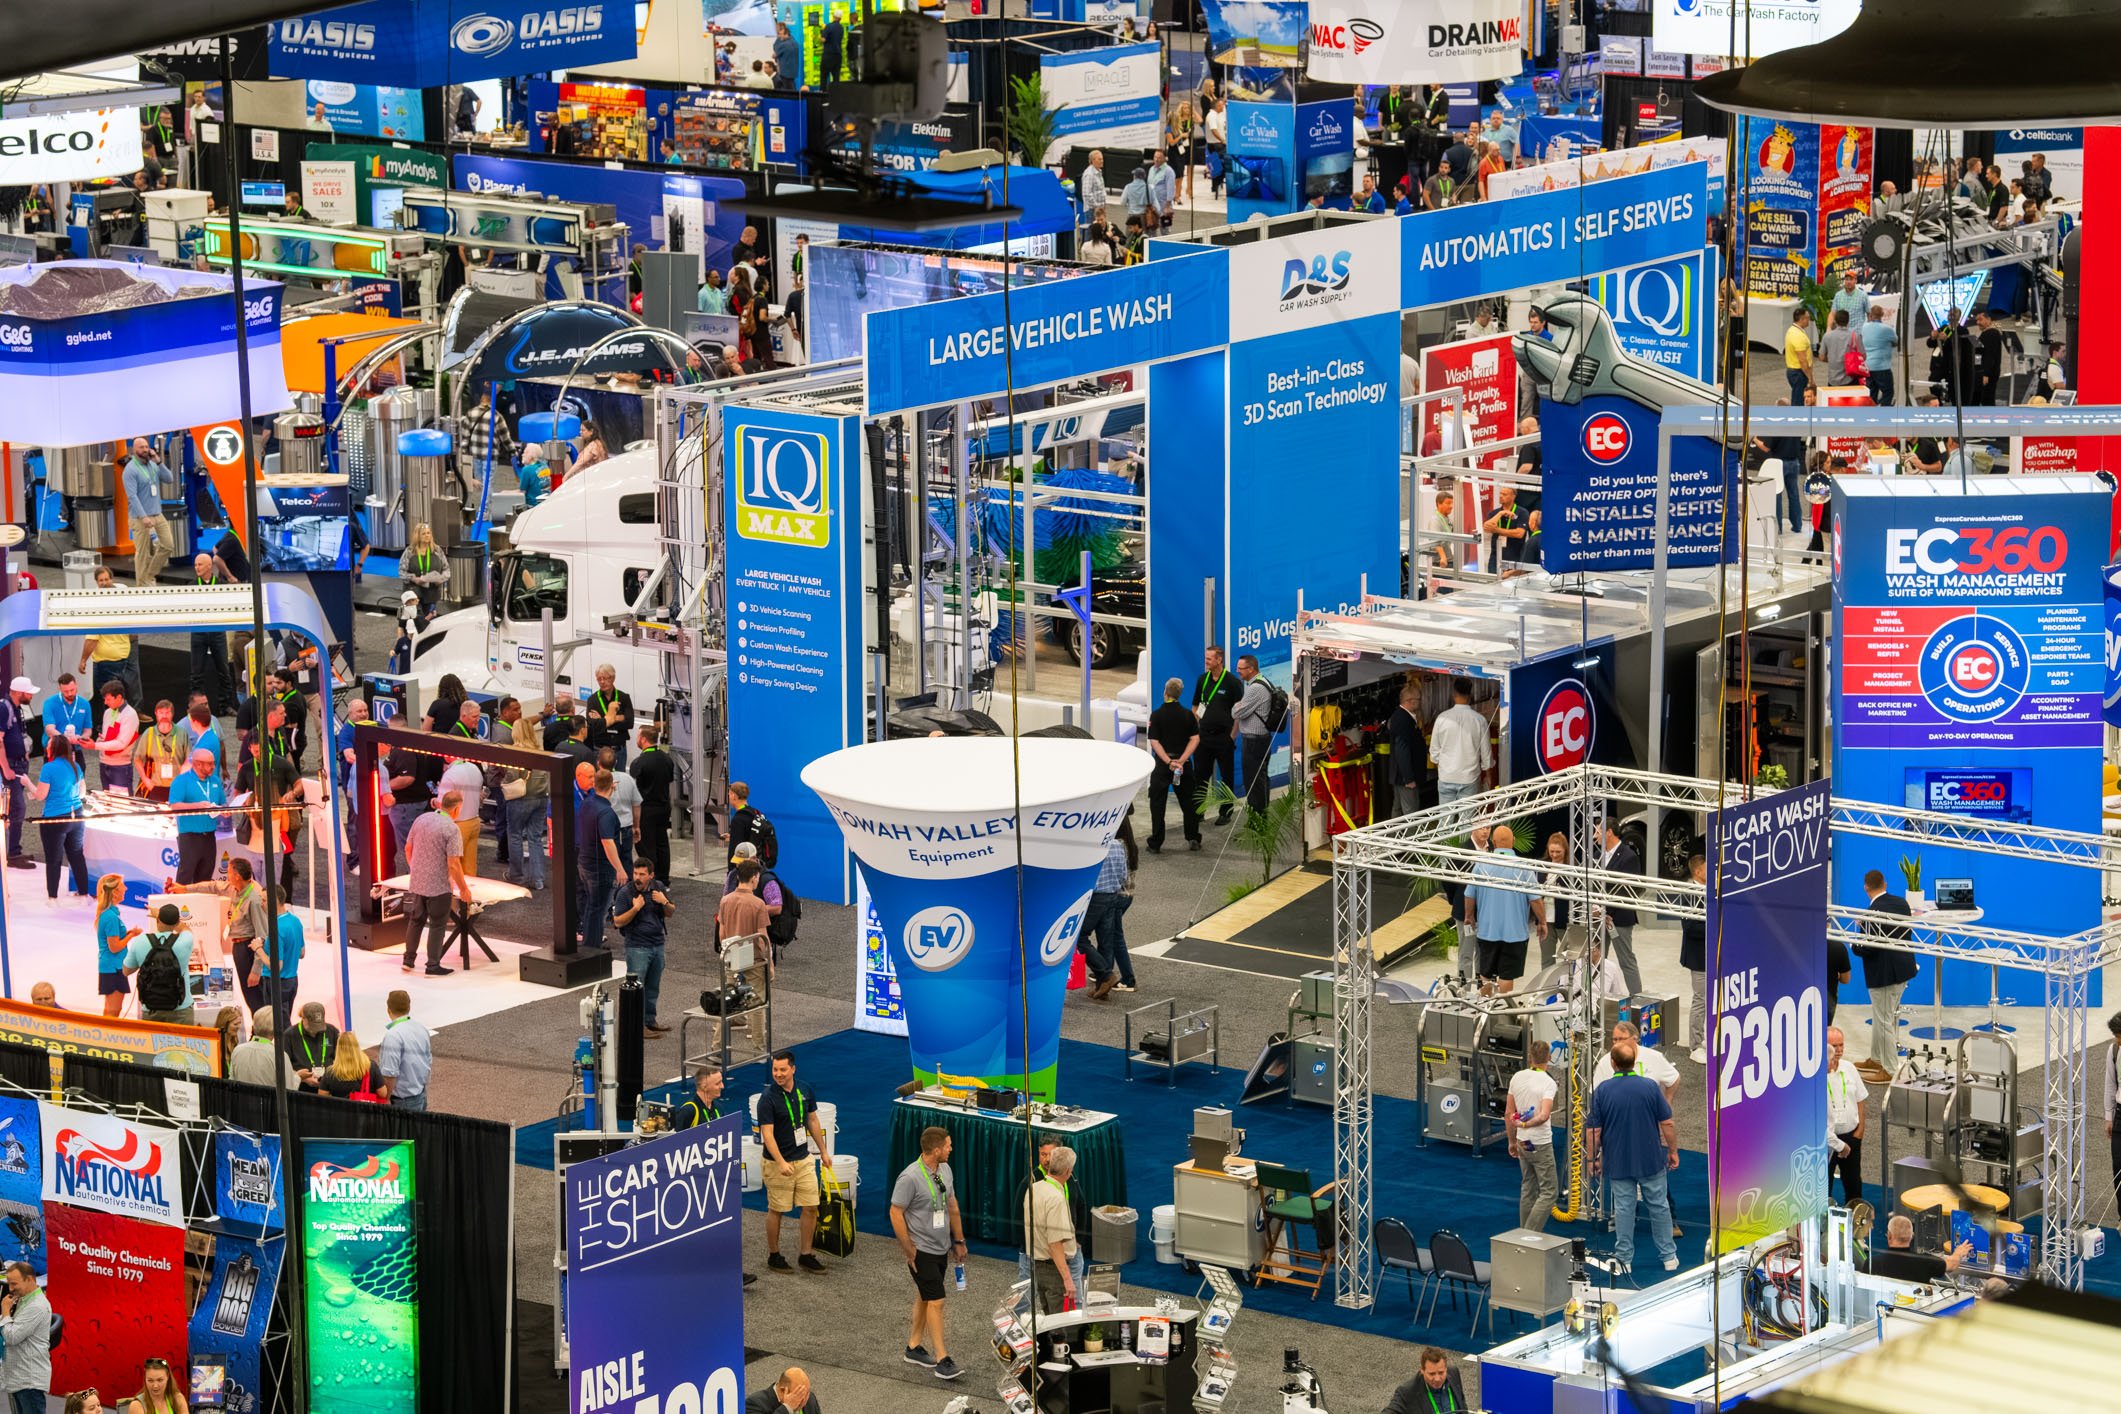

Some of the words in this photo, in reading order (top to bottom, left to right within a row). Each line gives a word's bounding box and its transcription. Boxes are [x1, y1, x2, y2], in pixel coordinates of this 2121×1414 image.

[519, 5, 603, 40] OASIS
[1703, 5, 1723, 17] The
[1778, 9, 1820, 24] Factory
[281, 18, 375, 50] OASIS
[1428, 16, 1520, 48] DRAINVAC
[282, 45, 298, 54] Car
[303, 47, 328, 57] Wash
[333, 50, 376, 60] Systems
[521, 41, 536, 49] Car
[540, 37, 562, 47] Wash
[1428, 49, 1443, 58] Car
[1446, 47, 1481, 57] Detailing
[1240, 126, 1254, 137] Car
[1256, 127, 1278, 138] Wash
[2026, 129, 2073, 142] celticbank
[0, 130, 94, 157] elco
[386, 159, 438, 182] myAnalyst
[1751, 176, 1786, 187] LOOKING
[1773, 213, 1795, 225] SELL
[1420, 222, 1553, 271] AUTOMATICS
[1574, 209, 1619, 243] SELF
[1623, 193, 1693, 233] SERVES
[1761, 234, 1790, 245] ONLY!
[1750, 261, 1769, 272] CAR
[1771, 262, 1800, 273] WASH
[1750, 271, 1770, 280] REAL
[1750, 281, 1778, 292] SINCE
[1779, 283, 1799, 293] 1998
[1280, 302, 1294, 312] CAR
[1297, 299, 1318, 309] WASH
[1320, 293, 1347, 305] SUPPLY
[0, 324, 33, 346] G&G
[66, 330, 112, 346] ggled.net
[929, 326, 1005, 366] LARGE
[1008, 307, 1103, 351] VEHICLE
[1107, 293, 1172, 331] WASH
[1267, 359, 1364, 393] Best-in-Class
[1243, 402, 1264, 425] 3D
[1267, 398, 1302, 420] Scan
[1305, 381, 1388, 411] Technology
[1468, 386, 1500, 403] Loyalty,
[1480, 400, 1507, 415] Profits
[1053, 416, 1082, 443] IQ
[1590, 426, 1624, 451] EC
[1829, 448, 1854, 458] Wash
[747, 435, 820, 514] IQ
[1590, 476, 1610, 487] Did
[1613, 477, 1634, 488] you
[1670, 470, 1708, 482] there's
[279, 497, 312, 507] Telco
[1573, 490, 1632, 502] ANOTHER
[1681, 485, 1696, 496] for
[1565, 505, 1657, 523] INSTALLS,
[748, 512, 816, 540] MAX
[1569, 530, 1582, 544] &
[1569, 550, 1600, 561] other
[1604, 547, 1631, 558] than
[1885, 526, 2068, 575] EC360
[744, 568, 768, 580] LARGE
[769, 571, 799, 584] VEHICLE
[800, 575, 822, 586] WASH
[1885, 575, 1937, 588] WASH
[1943, 573, 2067, 588] MANAGEMENT
[736, 578, 756, 588] EVERY
[758, 580, 779, 591] TRUCK
[788, 585, 802, 594] ANY
[803, 588, 831, 598] VEHICLE
[1888, 588, 1917, 597] SUITE
[1919, 588, 1933, 597] OF
[1935, 587, 2012, 597] WRAPAROUND
[2013, 587, 2063, 596] SERVICES
[760, 605, 782, 616] Vehicle
[783, 608, 812, 622] Scanning
[749, 621, 778, 633] Precision
[779, 625, 805, 639] Profiling
[1238, 625, 1261, 649] Big
[749, 639, 774, 651] Custom
[775, 642, 792, 653] Wash
[794, 645, 829, 658] Experience
[1867, 642, 1903, 650] REMODELS
[1930, 633, 1955, 661] BUILD
[1993, 630, 2020, 668] SERVICE
[750, 658, 795, 672] High-Powered
[796, 664, 824, 677] Cleaning
[1956, 656, 1993, 681] EC
[751, 675, 772, 688] Energy
[774, 678, 795, 691] Saving
[796, 681, 818, 694] Design
[1868, 709, 1907, 717] MARKETING
[1943, 696, 2006, 714] OPERATIONS
[2042, 712, 2090, 720] MANAGEMENT
[1546, 706, 1585, 759] EC
[1928, 733, 1970, 741] DAY-TO-DAY
[1971, 732, 2014, 740] OPERATIONS
[1930, 782, 2005, 801] EC360
[1032, 810, 1119, 830] ETOWAH
[1734, 810, 1771, 840] CAR
[1776, 793, 1824, 829] WASH
[916, 816, 1017, 842] VALLEY
[909, 846, 995, 866] Equipment
[1734, 818, 1823, 882] SHOW
[1060, 909, 1084, 941] EV
[919, 924, 958, 948] EV
[1712, 966, 1758, 1016] AISLE
[1713, 986, 1822, 1111] 2300
[605, 1158, 659, 1198] CAR
[665, 1131, 733, 1179] WASH
[56, 1152, 170, 1208] NATIONAL
[310, 1176, 405, 1203] NATIONAL
[76, 1190, 126, 1208] automotive
[129, 1201, 170, 1217] chemical
[606, 1161, 732, 1250] SHOW
[312, 1222, 327, 1232] Top
[330, 1223, 361, 1232] Quality
[363, 1223, 406, 1232] Chemicals
[578, 1174, 602, 1260] THE
[336, 1233, 358, 1241] Since
[361, 1233, 383, 1241] 1979
[58, 1237, 77, 1256] Top
[80, 1243, 117, 1263] Quality
[119, 1248, 172, 1272] Chemicals
[86, 1260, 113, 1278] Since
[117, 1265, 144, 1284] 1979
[224, 1271, 253, 1302] BIG
[217, 1298, 248, 1326] DOG
[213, 1322, 244, 1335] POWDER
[580, 1350, 645, 1414] AISLE
